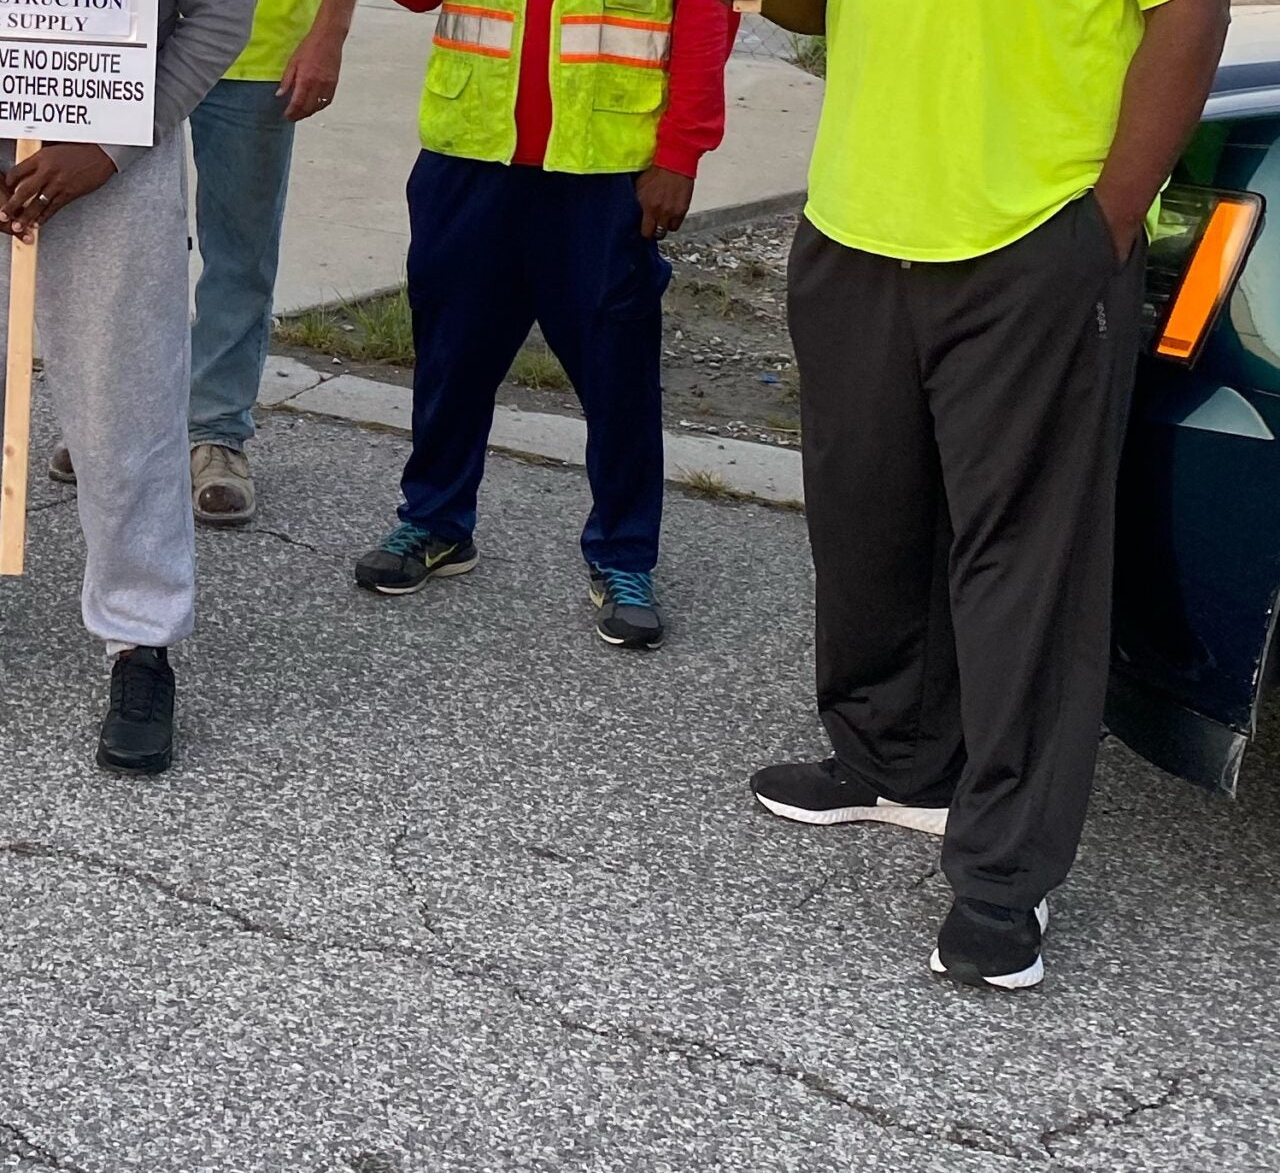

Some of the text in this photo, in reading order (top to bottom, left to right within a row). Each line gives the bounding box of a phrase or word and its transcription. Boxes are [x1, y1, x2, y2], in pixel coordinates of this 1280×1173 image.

[8, 13, 88, 31] SUPPLY
[24, 50, 47, 69] NO
[52, 51, 120, 73] DISPUTE
[3, 75, 58, 96] OTHER
[63, 78, 144, 101] BUSINESS
[0, 101, 91, 125] EMPLOYER.
